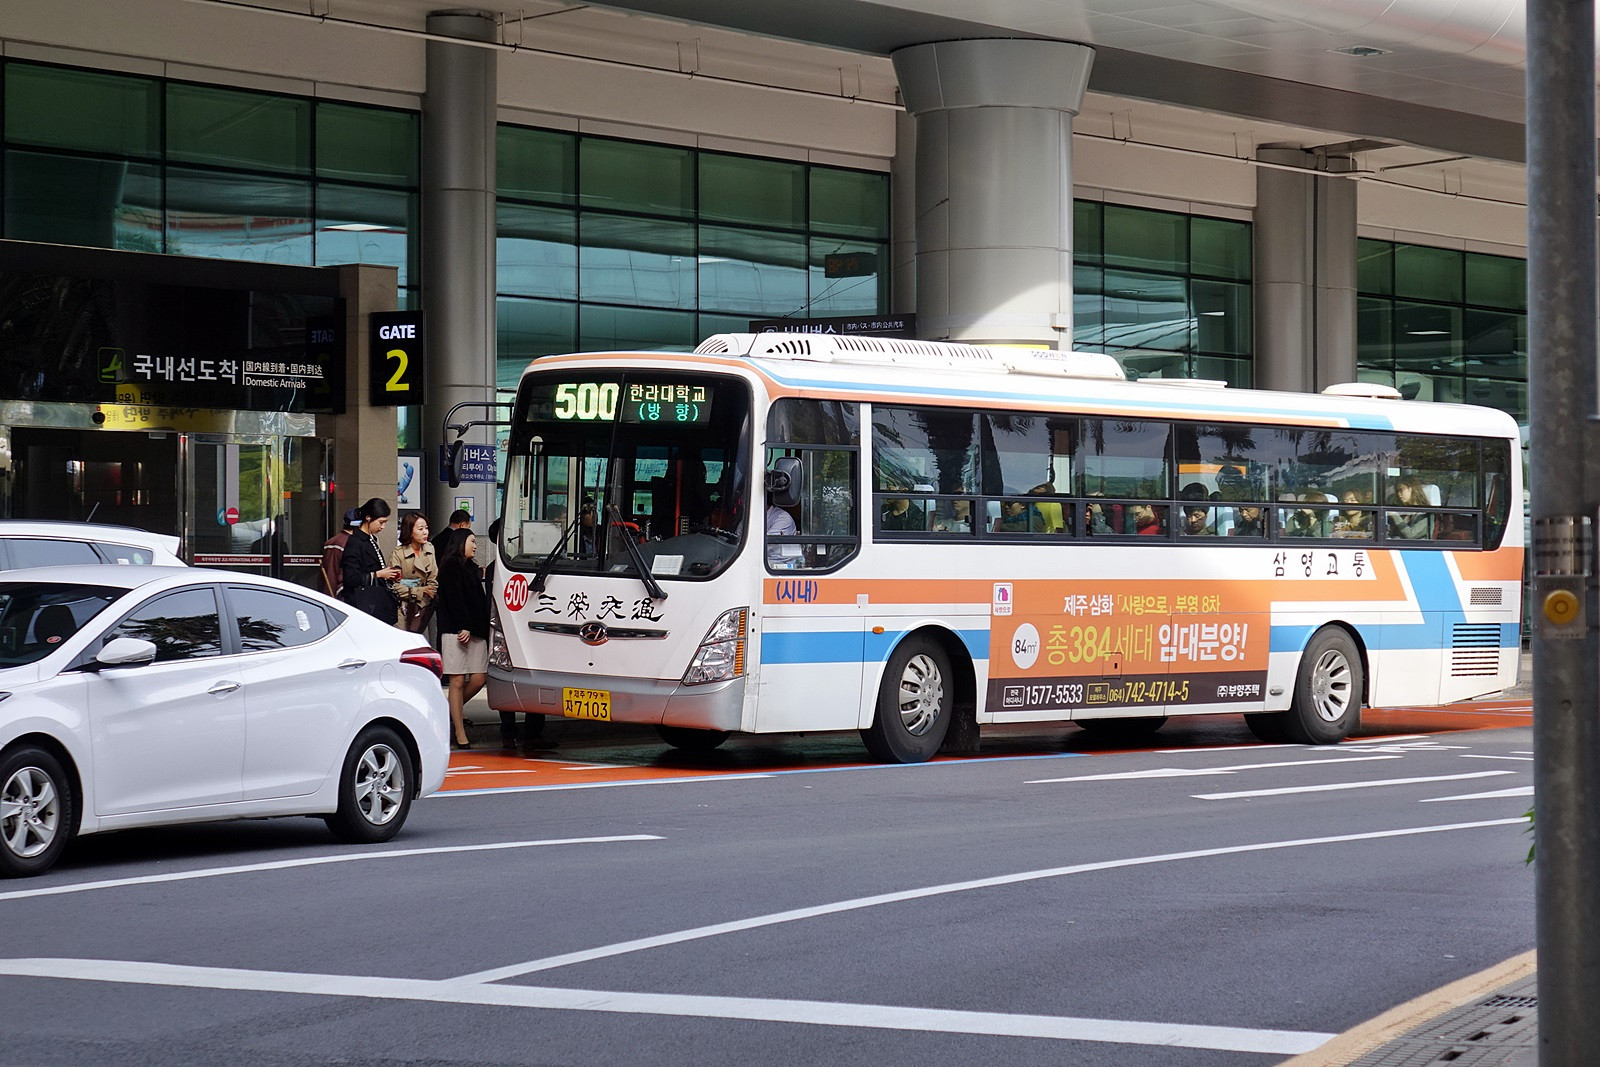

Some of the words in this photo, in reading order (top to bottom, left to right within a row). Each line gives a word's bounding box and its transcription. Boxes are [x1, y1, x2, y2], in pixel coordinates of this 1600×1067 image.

[379, 325, 416, 339] GATE
[133, 354, 239, 385] 국내선도착
[385, 349, 410, 392] 2
[245, 377, 279, 388] Domestic
[279, 378, 307, 389] Arrivals
[630, 384, 706, 403] 한라대학교
[554, 382, 620, 421] 500
[505, 579, 528, 608] 500
[776, 579, 818, 603] (시내)
[1063, 594, 1089, 616] 제주
[1089, 594, 1114, 616] 삼화
[1175, 594, 1199, 616] 부영
[1201, 594, 1221, 615] 8차
[1158, 623, 1248, 662] 임대분양!
[573, 689, 586, 699] 제주
[587, 690, 599, 700] 79
[1026, 683, 1083, 705] 1577-5533
